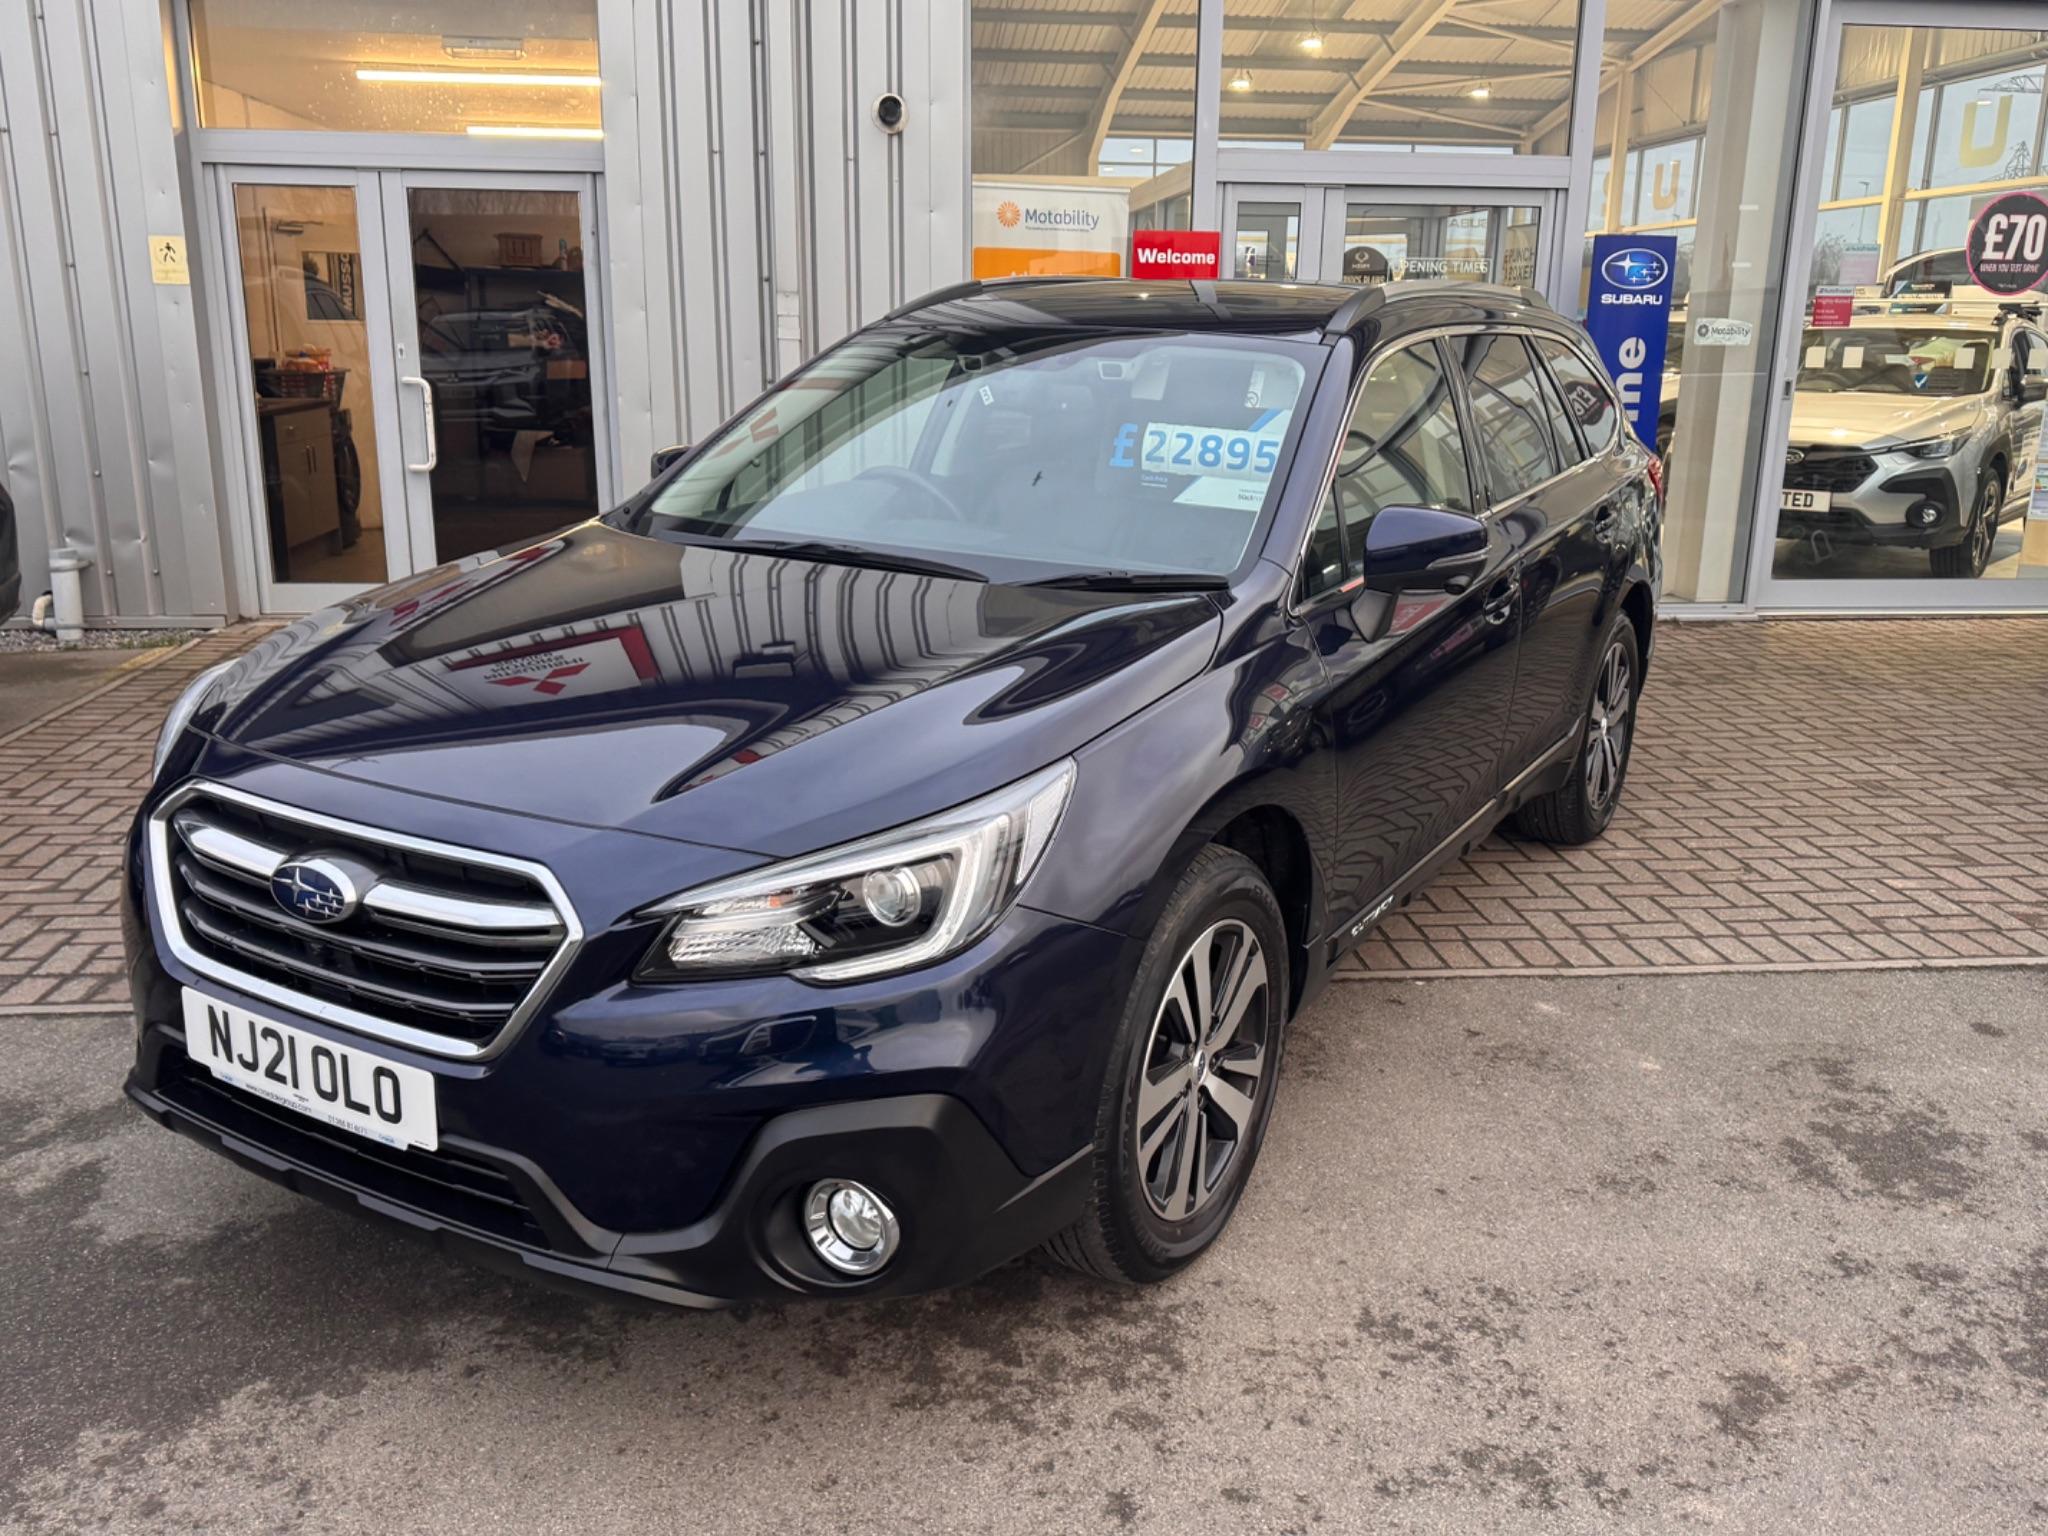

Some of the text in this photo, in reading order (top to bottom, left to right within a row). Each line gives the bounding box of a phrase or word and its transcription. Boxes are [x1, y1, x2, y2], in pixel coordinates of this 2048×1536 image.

[1024, 207, 1099, 231] Motability
[1981, 213, 2047, 261] £70
[1137, 247, 1216, 265] Welcome
[1452, 261, 1489, 274] TIMES
[1601, 293, 1662, 305] SUBARU
[1109, 422, 1279, 475] £22895
[1782, 491, 1814, 508] TED
[207, 1003, 403, 1125] NJ21 OLO
